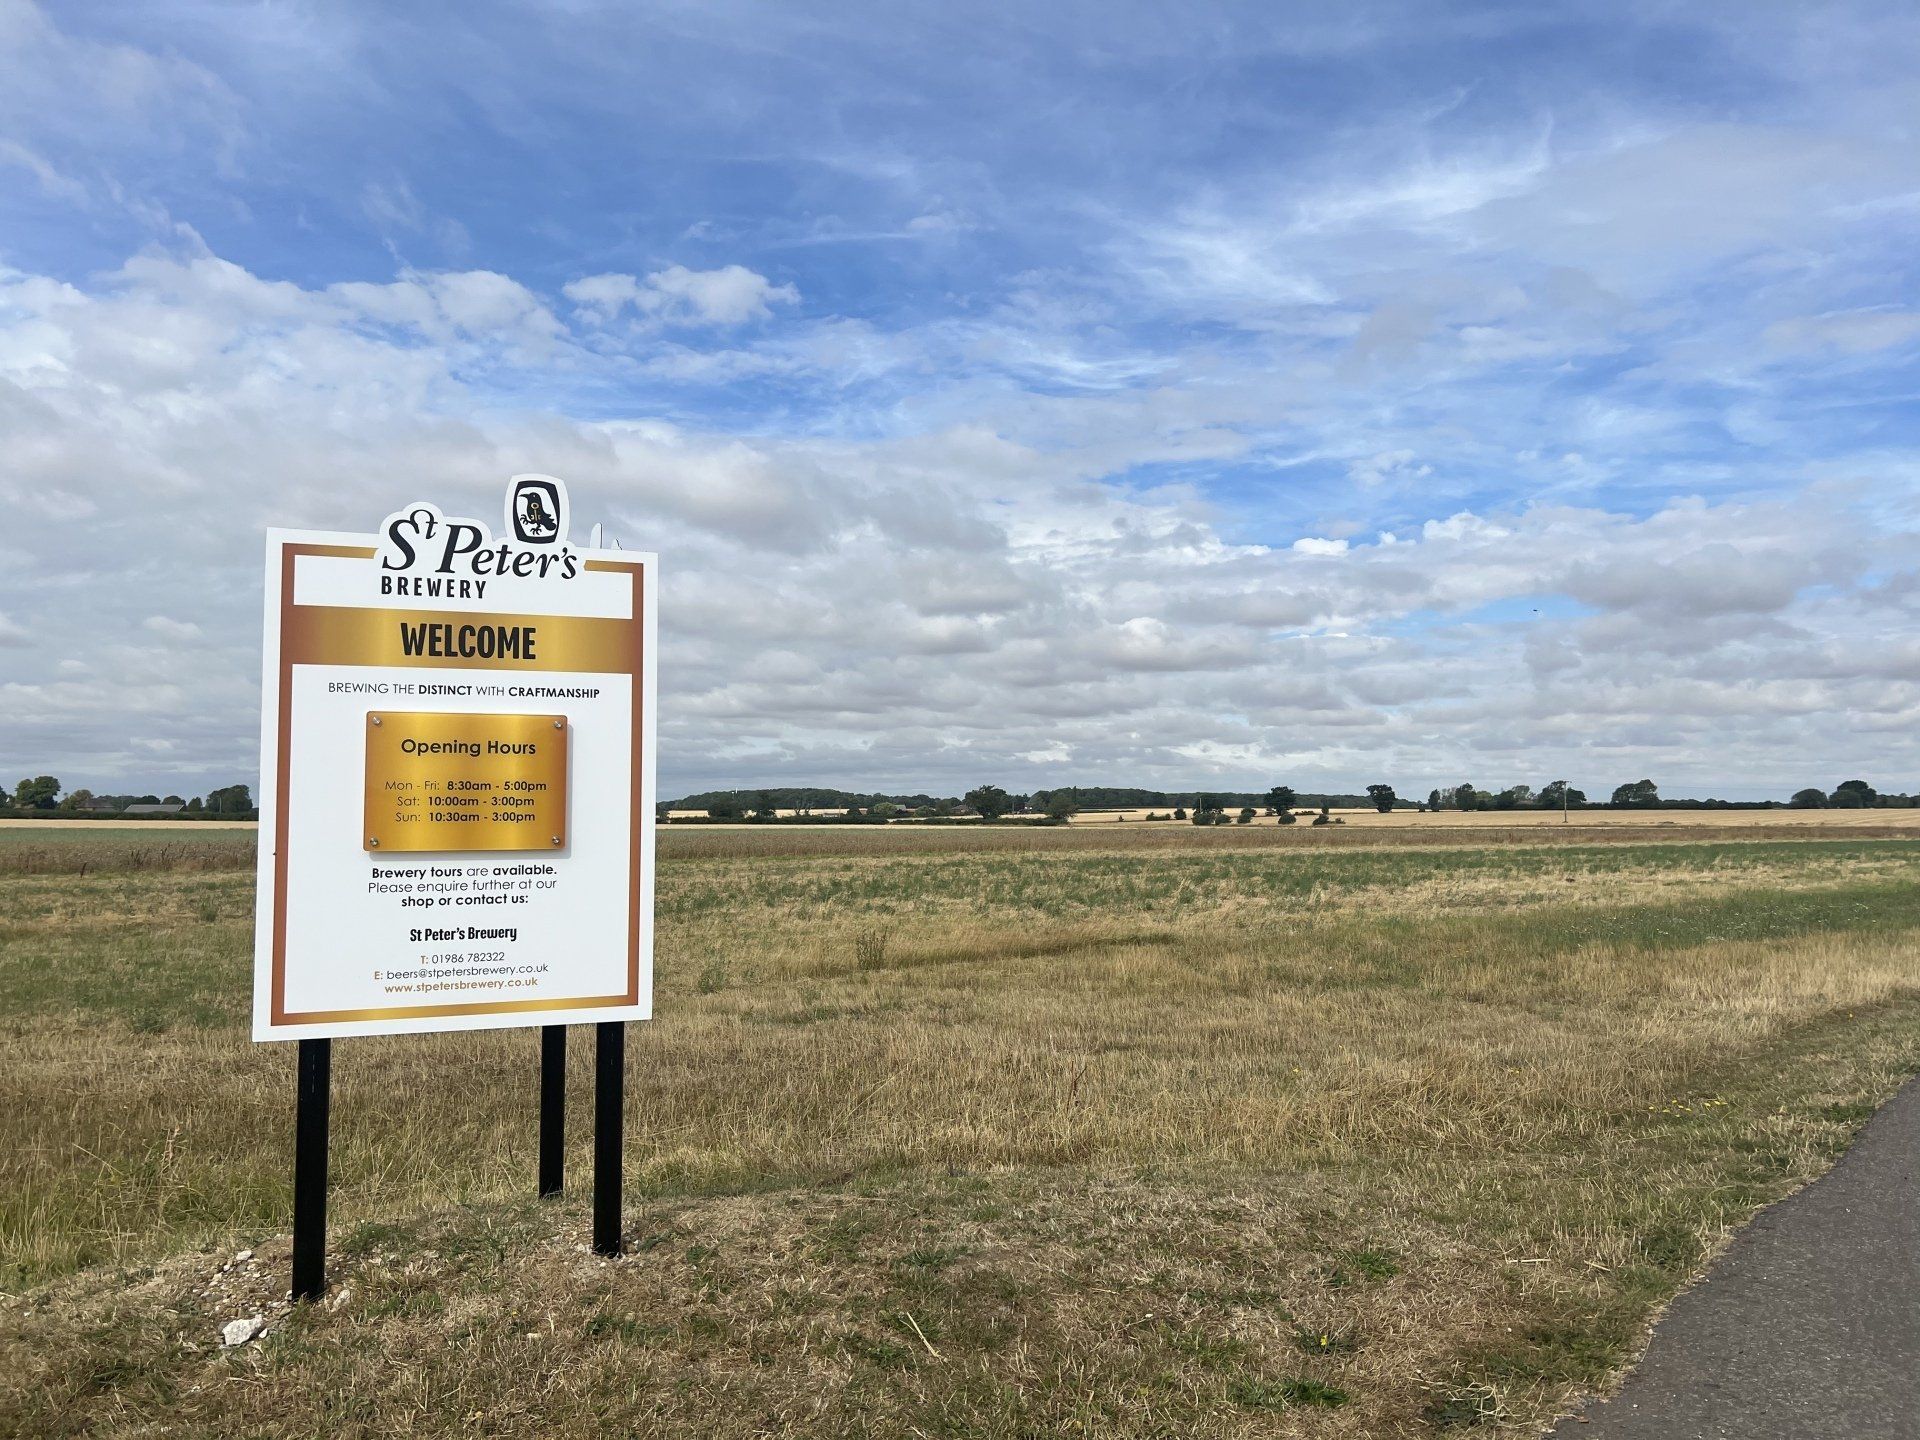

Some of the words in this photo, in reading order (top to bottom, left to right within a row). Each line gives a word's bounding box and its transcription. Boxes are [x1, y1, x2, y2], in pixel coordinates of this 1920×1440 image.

[435, 524, 577, 579] Peter's
[381, 576, 487, 599] BREWERY
[401, 623, 536, 659] WELCOME
[328, 682, 389, 695] BREWING
[393, 683, 414, 695] THE
[418, 684, 471, 696] DISTINCT
[475, 686, 504, 697] WITH
[508, 687, 599, 698] CRAFTMANSHIP
[401, 739, 480, 756] Opening
[488, 740, 536, 754] Hours
[385, 780, 412, 790] Mon
[425, 780, 440, 790] Fri:
[447, 781, 491, 790] 8:30am
[504, 781, 546, 793] 5:00pm
[397, 796, 420, 806] Sat:
[428, 797, 478, 806] 10:00am
[491, 797, 534, 808] 3:00pm
[395, 812, 421, 822] Sun:
[429, 812, 479, 822] 10:30am
[492, 812, 535, 824] 3:00pm
[372, 867, 426, 880] Brewery
[430, 866, 462, 877] tours
[466, 866, 488, 876] are
[493, 864, 556, 875] available.
[368, 882, 412, 893] Please
[417, 881, 467, 893] enquire
[472, 879, 515, 890] further
[519, 879, 532, 889] at
[536, 879, 556, 888] our
[401, 896, 434, 909] shop
[438, 897, 452, 906] or
[456, 895, 506, 906] contact
[511, 895, 528, 904] us:
[410, 928, 422, 941] St
[425, 928, 465, 940] Peter's
[468, 926, 517, 941] Brewery
[421, 955, 428, 964] T:
[431, 953, 464, 964] 01986
[467, 952, 504, 962] 782322
[374, 971, 383, 980] E:
[387, 963, 548, 979] beers@stpetersbrewery.co.uk
[385, 977, 537, 993] www.stpetersbrewery.co.uk
